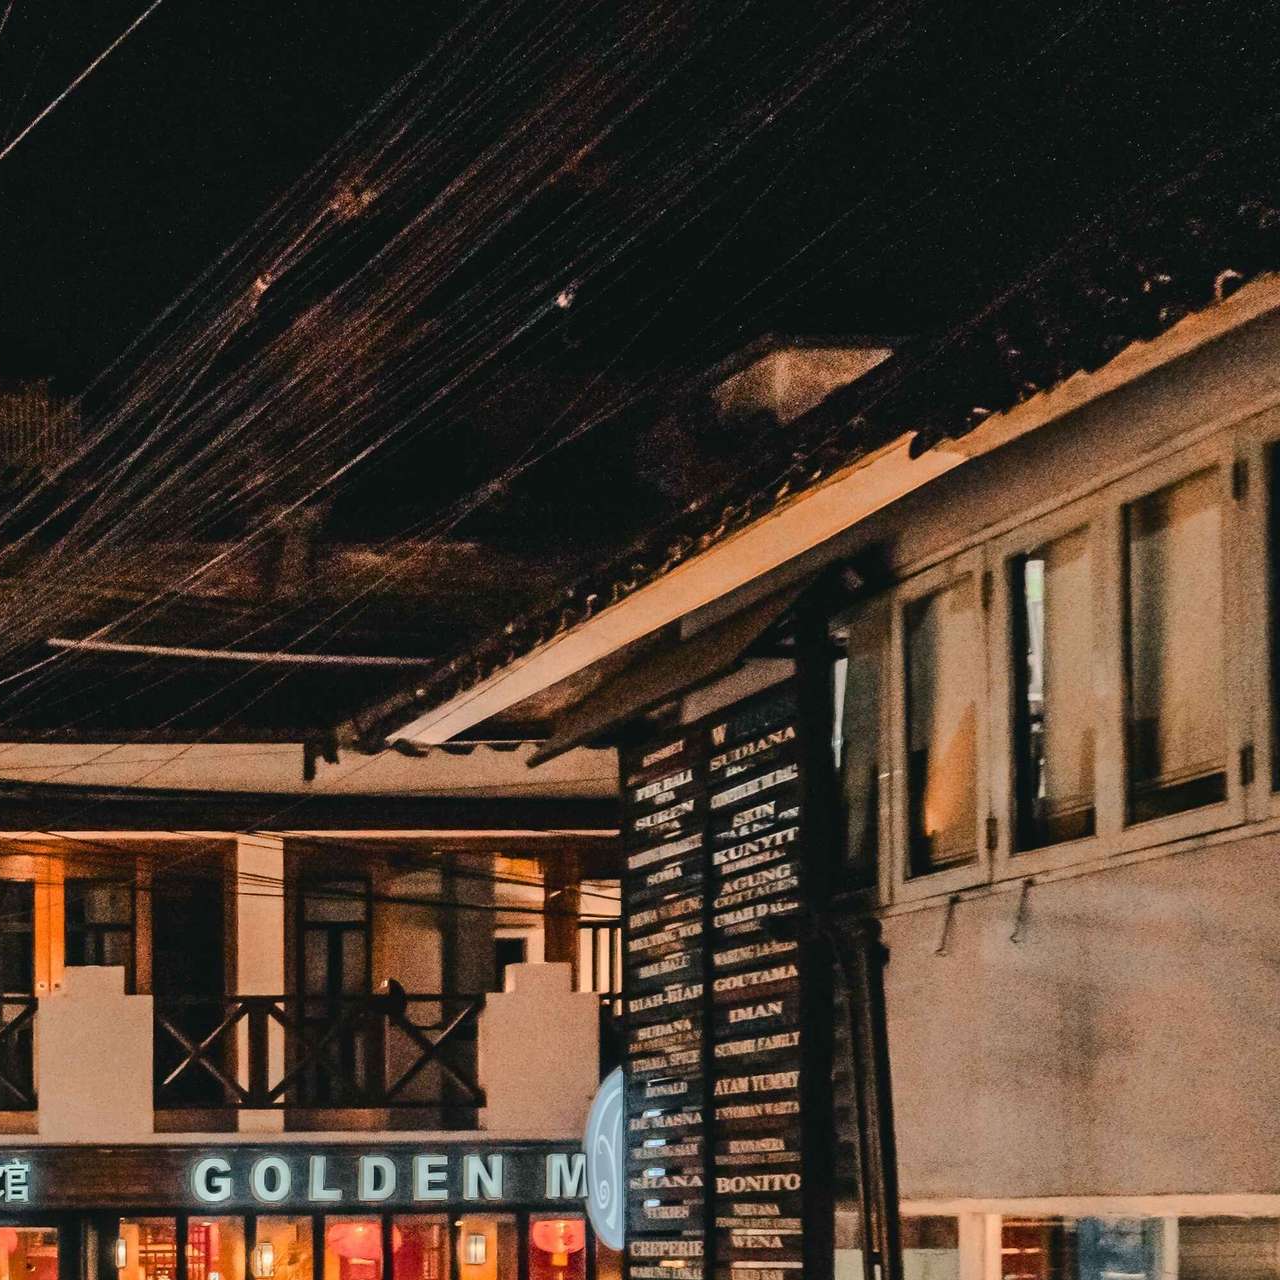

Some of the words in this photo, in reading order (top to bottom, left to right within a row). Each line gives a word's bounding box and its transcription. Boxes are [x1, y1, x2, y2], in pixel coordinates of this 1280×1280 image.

[712, 827, 799, 865] KUNYIT
[721, 863, 791, 895] AGUNG
[713, 965, 798, 991] GOUTAMA
[729, 1001, 784, 1023] IMAN
[192, 1154, 505, 1204] GOLDEN
[715, 1173, 801, 1194] BONITO
[630, 1240, 705, 1257] CREPERIE
[731, 1236, 784, 1248] WENA
